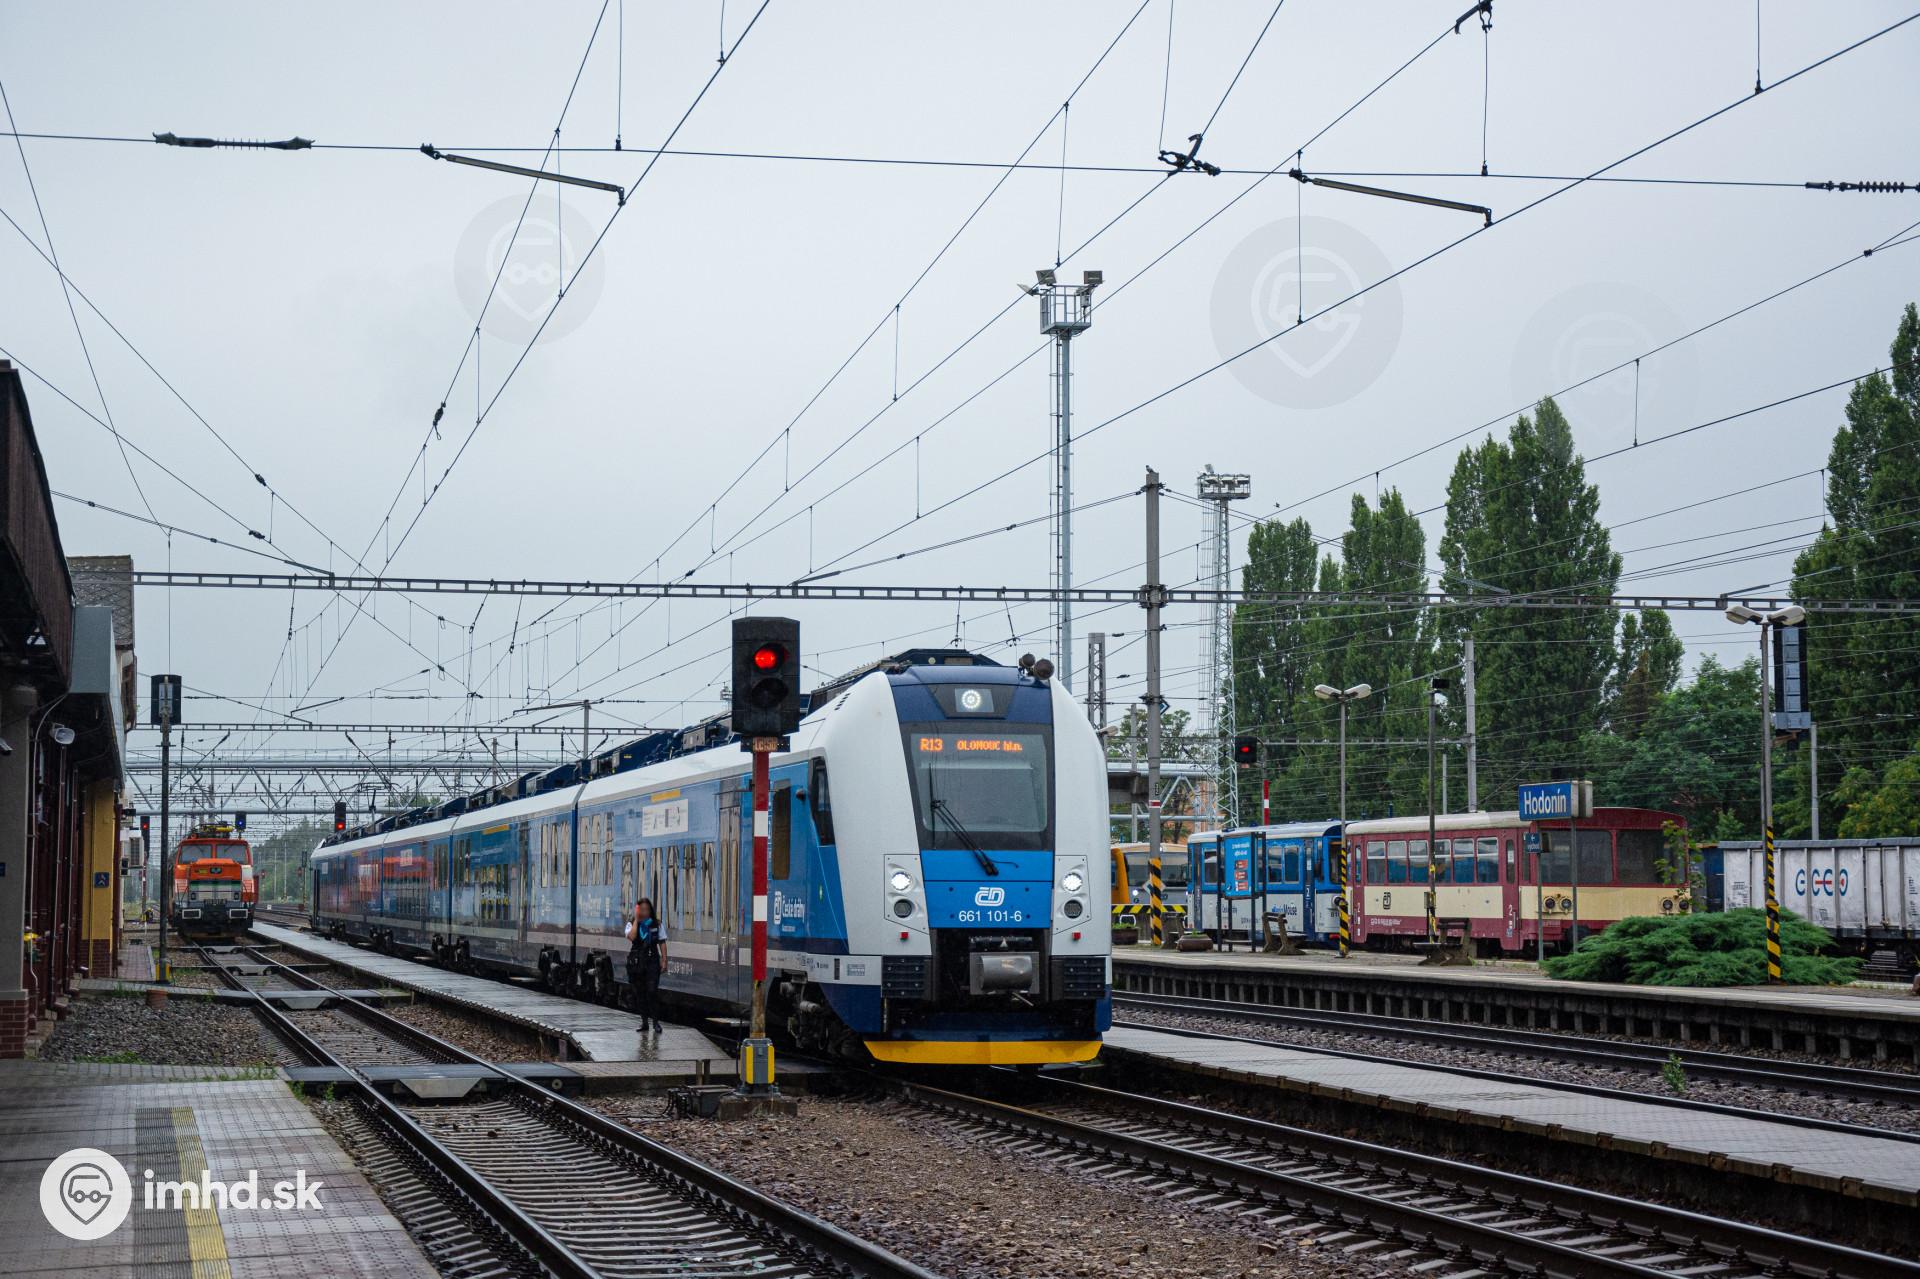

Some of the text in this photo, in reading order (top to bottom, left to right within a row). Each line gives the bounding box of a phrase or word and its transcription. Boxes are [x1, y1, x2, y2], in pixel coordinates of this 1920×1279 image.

[920, 737, 943, 752] R13
[956, 739, 1001, 751] OLOMOUC
[1524, 788, 1567, 815] Hodonín
[958, 910, 1022, 922] 661 101-6
